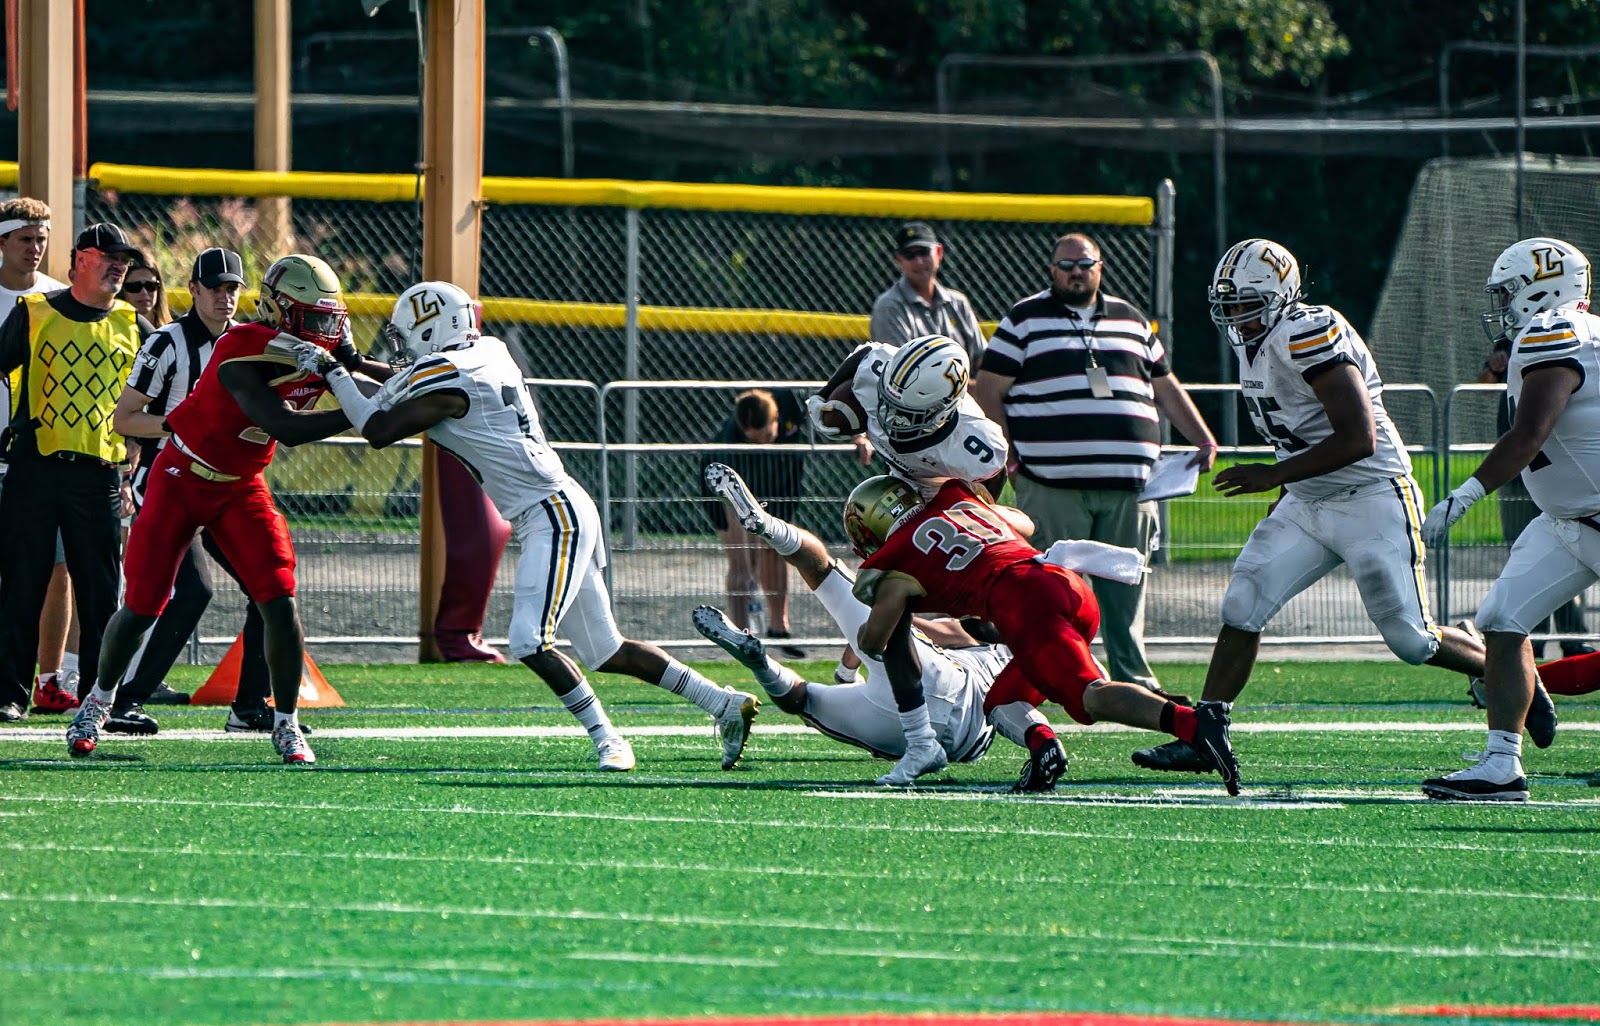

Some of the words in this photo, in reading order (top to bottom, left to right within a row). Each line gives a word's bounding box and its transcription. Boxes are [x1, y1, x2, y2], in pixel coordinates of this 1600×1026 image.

[1261, 246, 1292, 285] L
[1531, 246, 1564, 282] L
[409, 289, 441, 327] L
[963, 435, 994, 463] 9
[912, 500, 1017, 571] 30
